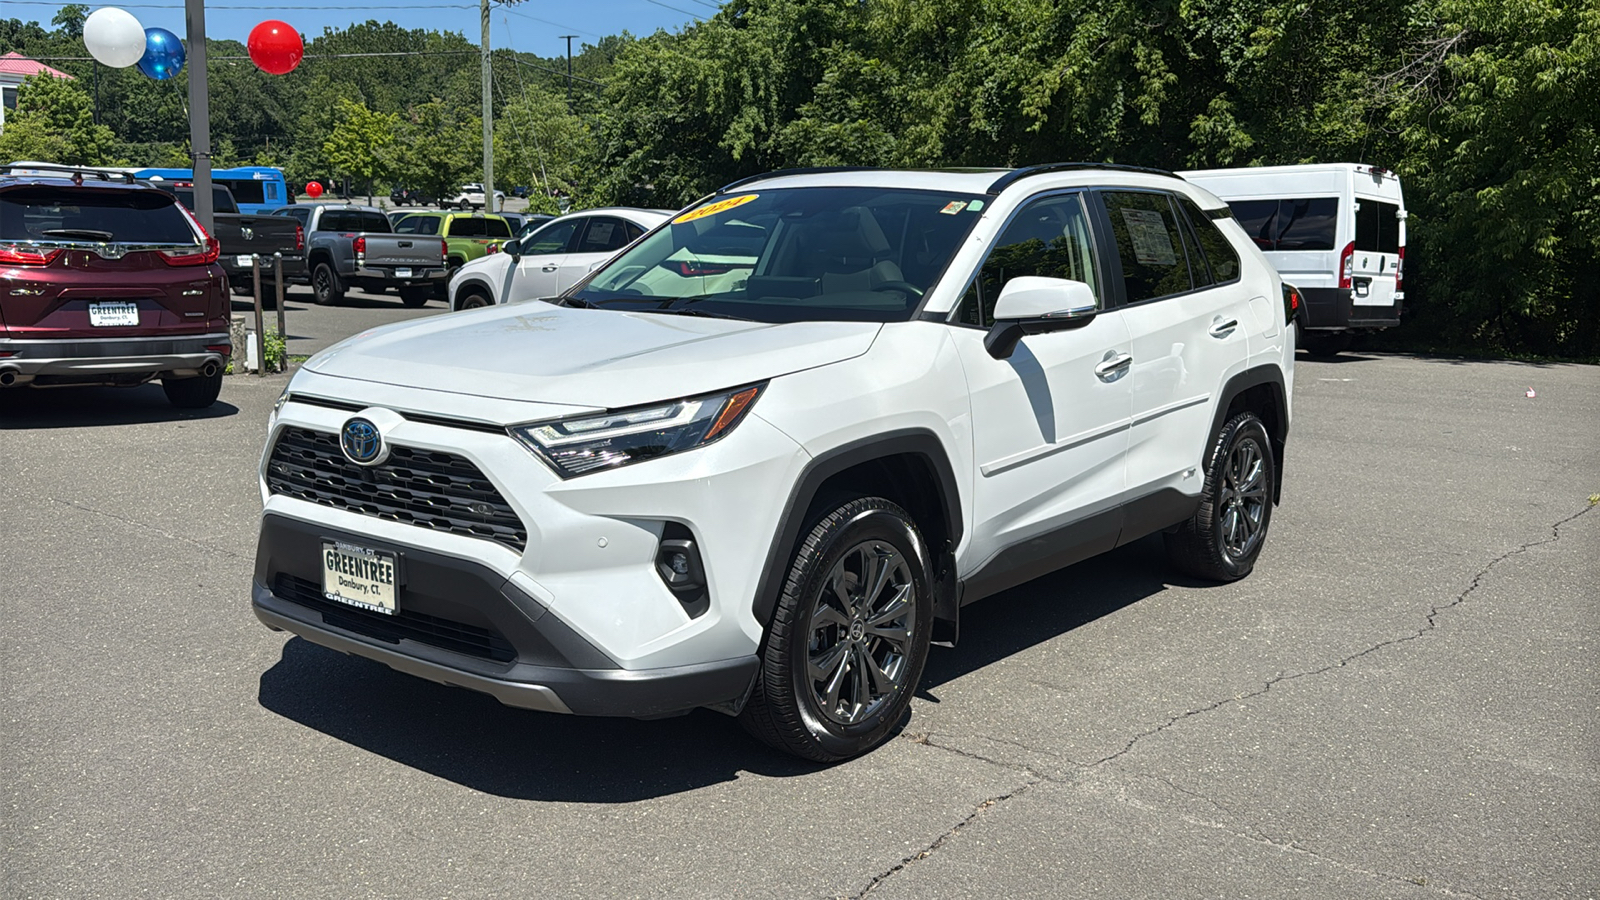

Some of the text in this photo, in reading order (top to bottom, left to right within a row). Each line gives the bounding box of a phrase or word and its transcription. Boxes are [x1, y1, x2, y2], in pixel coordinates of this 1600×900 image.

[684, 197, 746, 220] 2024
[91, 306, 136, 315] GREENTREE
[335, 541, 365, 555] DANBURY,
[326, 551, 392, 585] GREENTREE
[338, 576, 381, 596] Danbury, CT.
[325, 593, 393, 615] GREENTREE
